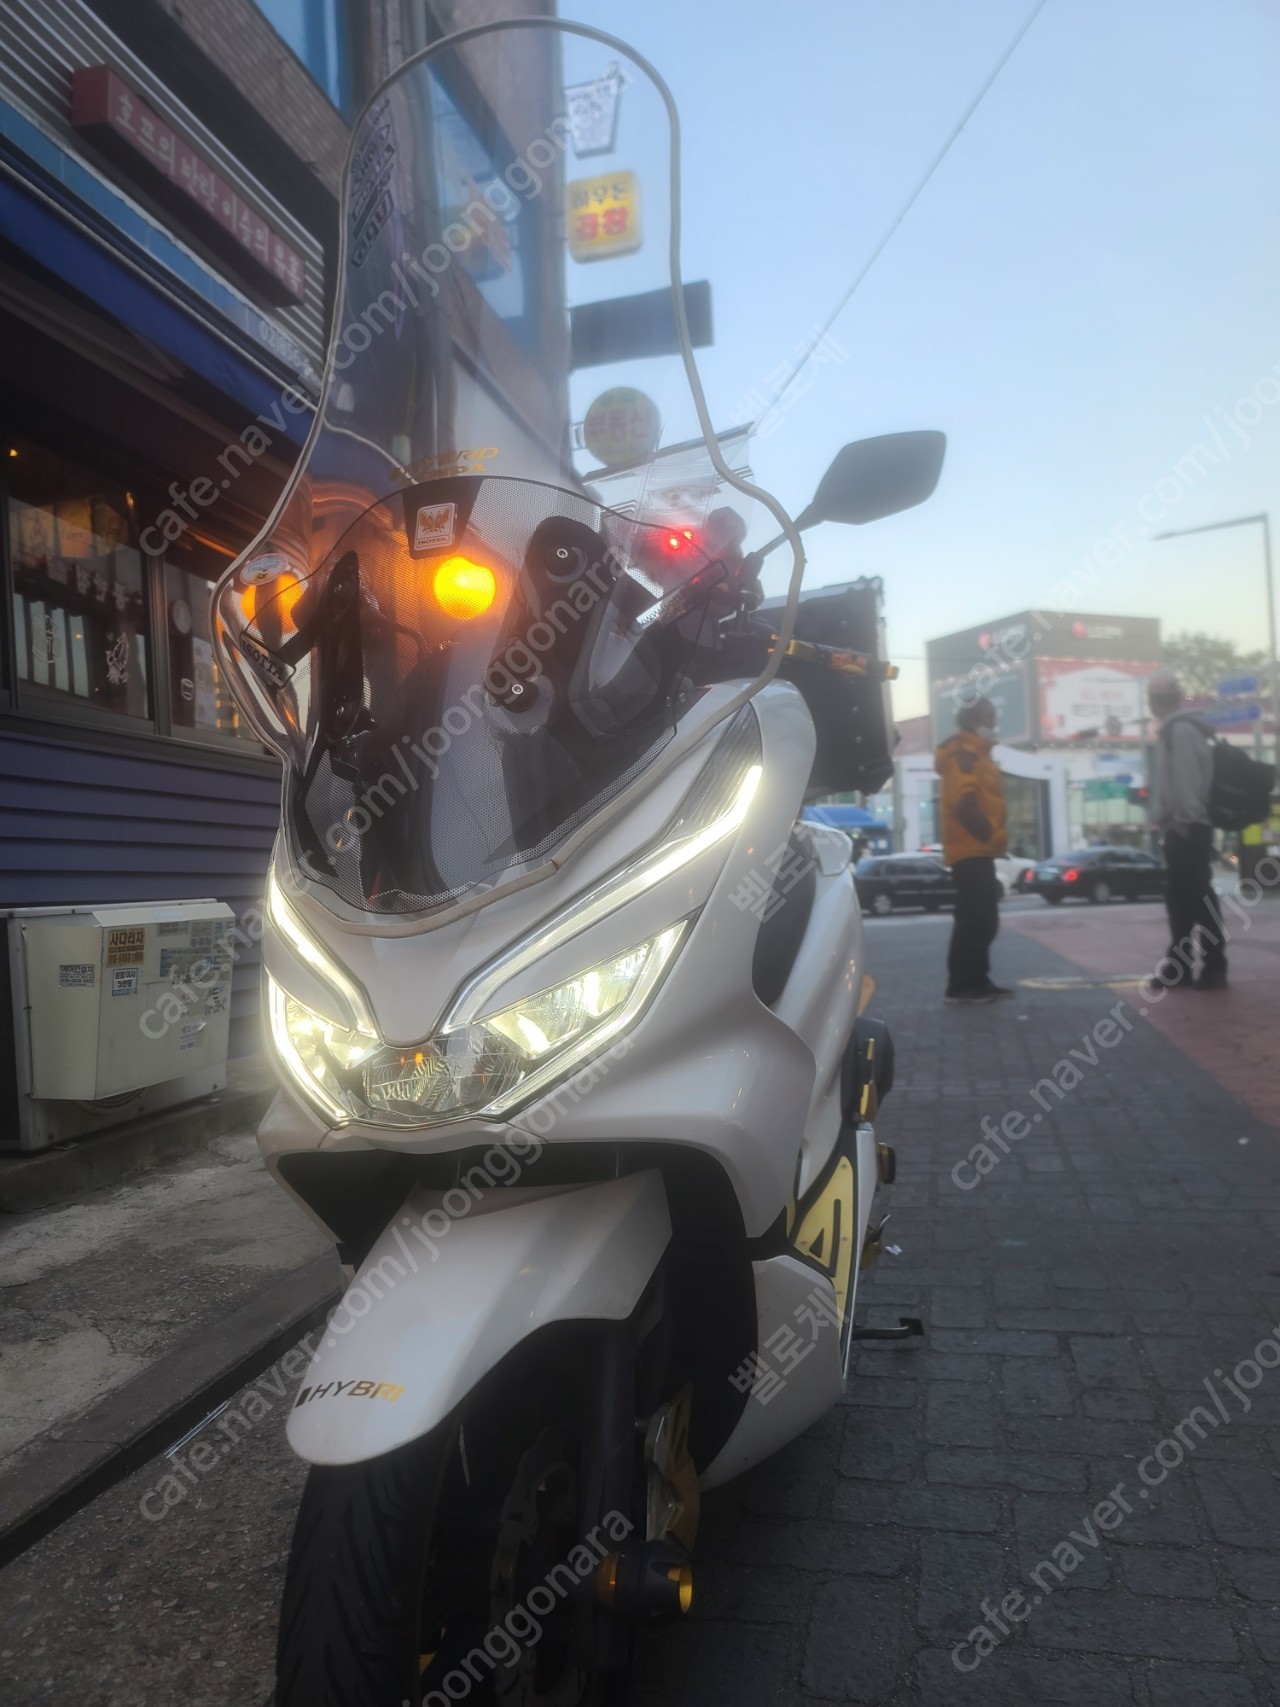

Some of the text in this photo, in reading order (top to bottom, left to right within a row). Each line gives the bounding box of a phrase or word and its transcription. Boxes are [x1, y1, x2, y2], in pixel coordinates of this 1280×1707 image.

[115, 93, 301, 295] 호프의 반란 이슬의 유혹
[241, 639, 284, 681] ISOTTA
